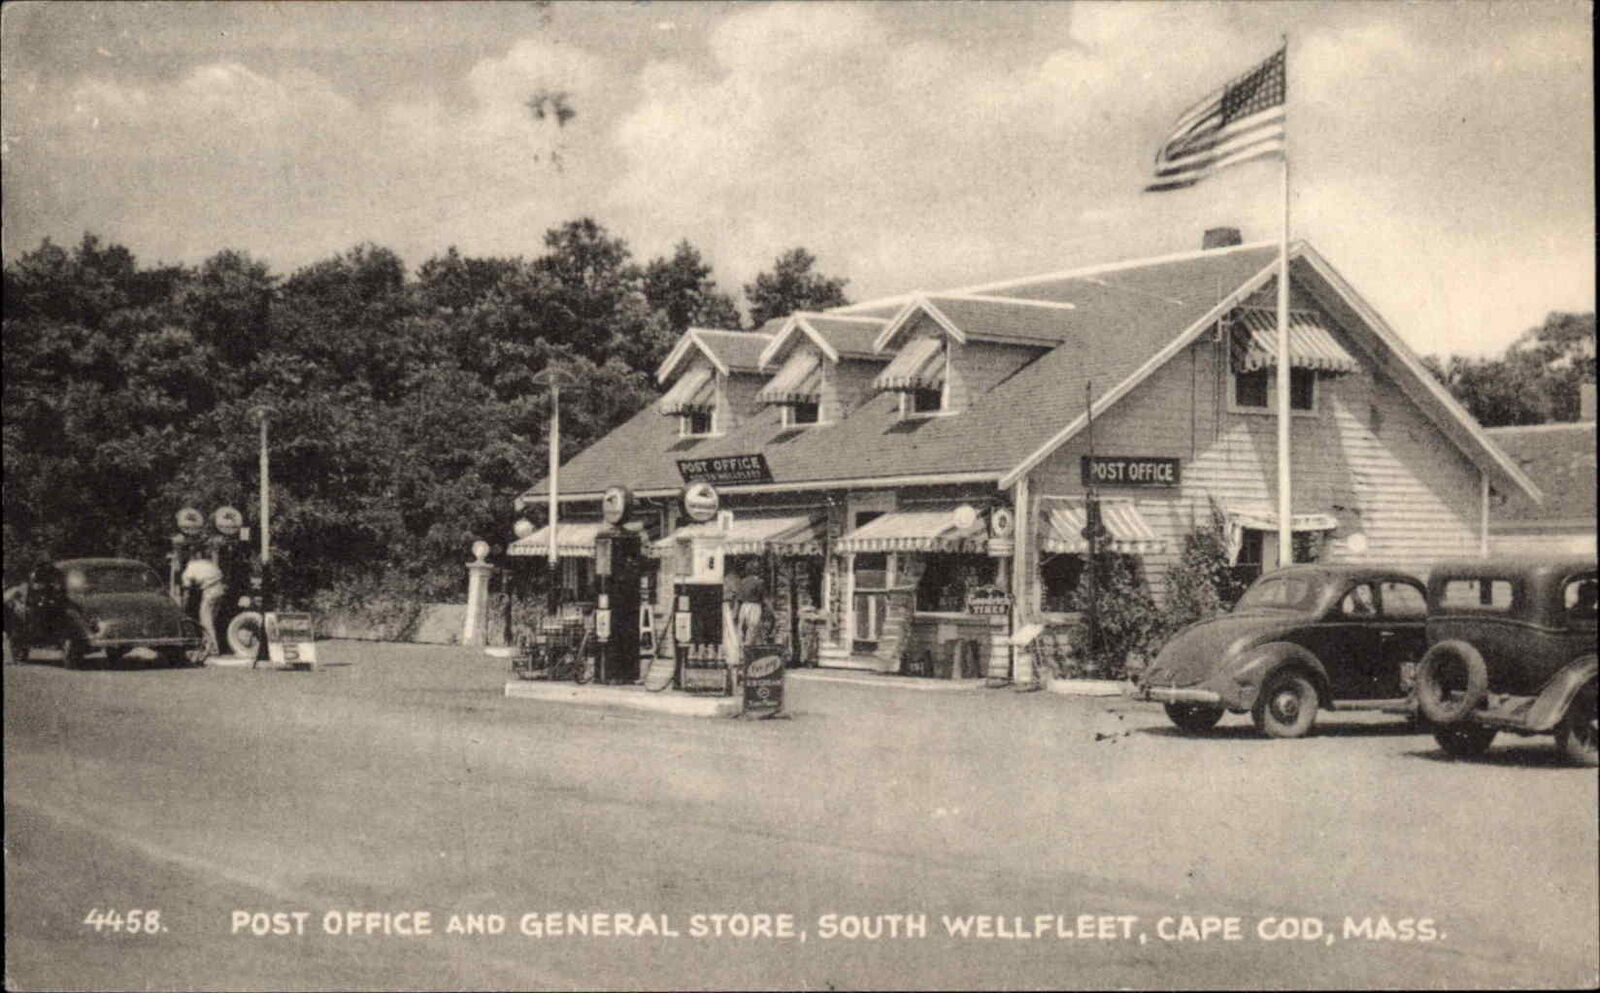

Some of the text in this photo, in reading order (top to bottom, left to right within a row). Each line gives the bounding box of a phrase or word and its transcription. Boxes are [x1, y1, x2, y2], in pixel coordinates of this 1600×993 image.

[681, 456, 760, 473] POST OFFICE
[1090, 462, 1173, 481] POST OFFICE
